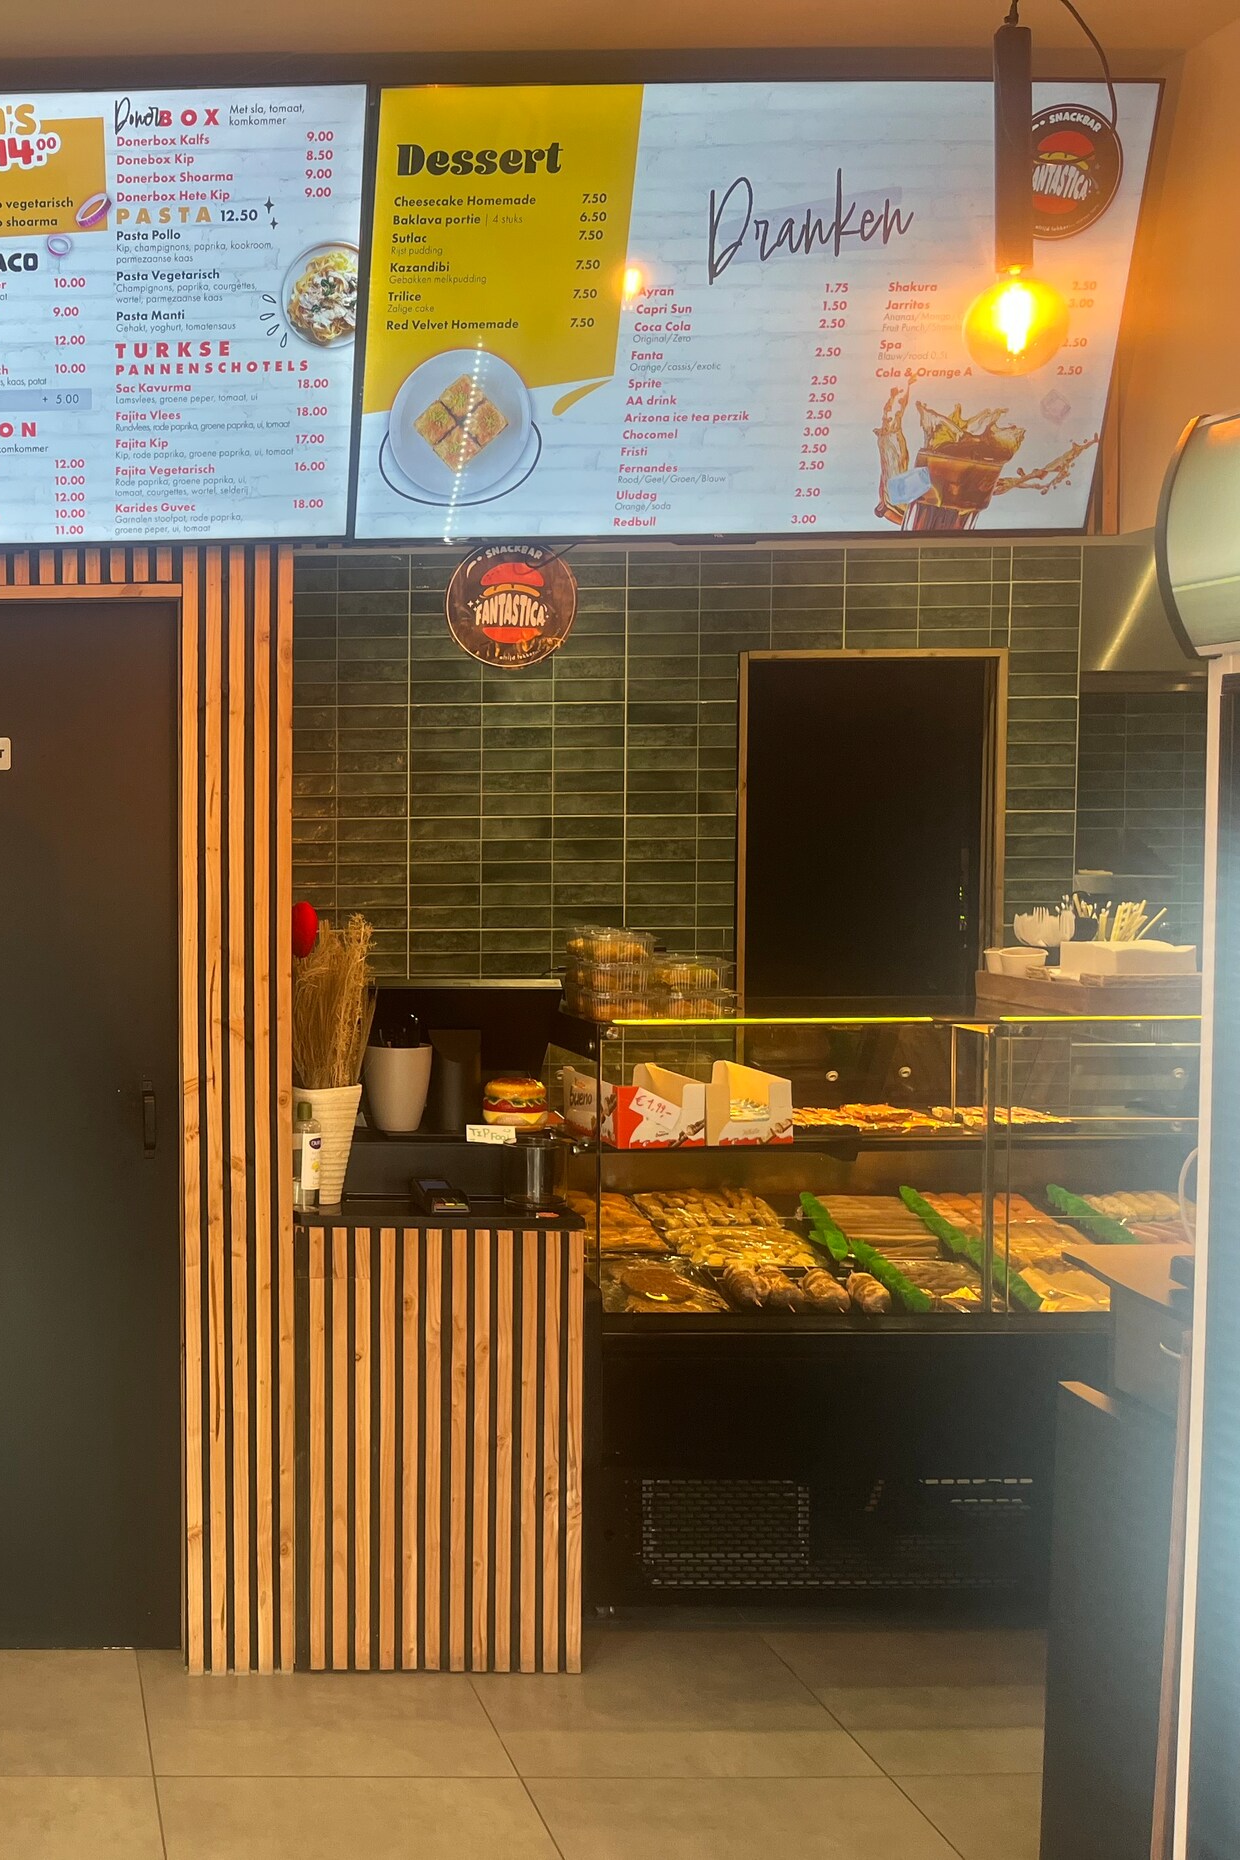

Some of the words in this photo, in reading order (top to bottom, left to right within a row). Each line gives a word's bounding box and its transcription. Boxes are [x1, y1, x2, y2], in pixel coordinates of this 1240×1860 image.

[230, 105, 248, 114] Met
[251, 105, 266, 114] sla,
[270, 104, 304, 114] tomaat,
[160, 109, 219, 126] BOX
[229, 116, 286, 126] komkommer
[1049, 112, 1101, 132] SNACKBAR
[117, 136, 177, 147] Donerbox
[180, 134, 210, 145] Kalfs
[307, 131, 334, 141] 9.00
[117, 155, 171, 166] Donebox
[175, 155, 194, 166] Kip
[307, 150, 333, 160] 8.50
[397, 142, 563, 176] Dessert
[1032, 164, 1090, 200] ANTASTICA
[6, 197, 73, 211] vegetarisch
[394, 196, 463, 207] Cheesecake
[467, 195, 536, 206] Homemade
[582, 193, 607, 204] 7.50
[117, 207, 212, 224] PASTA
[220, 210, 258, 221] 12.50
[393, 215, 442, 225] Baklava
[445, 214, 481, 227] portie
[493, 215, 498, 223] 4
[500, 215, 522, 223] stuks
[579, 212, 607, 222] 6.50
[708, 168, 914, 285] Dranken
[117, 231, 148, 240] Pasta
[152, 230, 181, 239] Pollo
[390, 262, 450, 273] Kazandibi
[575, 260, 600, 270] 7.50
[888, 282, 937, 292] Shakura
[636, 305, 667, 317] Capri
[671, 304, 692, 314] Sun
[823, 301, 847, 311] 1.50
[885, 300, 930, 310] Jarritos
[634, 322, 662, 332] Coca
[665, 322, 691, 331] Cola
[819, 319, 845, 329] 2.50
[633, 333, 691, 344] Original/Zero
[880, 340, 901, 350] Spa
[115, 341, 230, 359] TURKSE
[115, 360, 308, 376] PANNENSCHOTELS
[876, 368, 901, 377] Cola
[903, 368, 912, 377] &
[917, 367, 961, 378] Orange
[1057, 366, 1082, 375] 2.50
[116, 384, 135, 393] Sac
[139, 383, 191, 392] Kavurma
[298, 379, 329, 388] 18.00
[628, 379, 662, 390] Sprite
[811, 376, 837, 385] 2.50
[55, 493, 85, 502] 12.00
[486, 545, 543, 560] SNACKBAR
[475, 593, 545, 627] FANTASTICA
[570, 1085, 592, 1106] bueno
